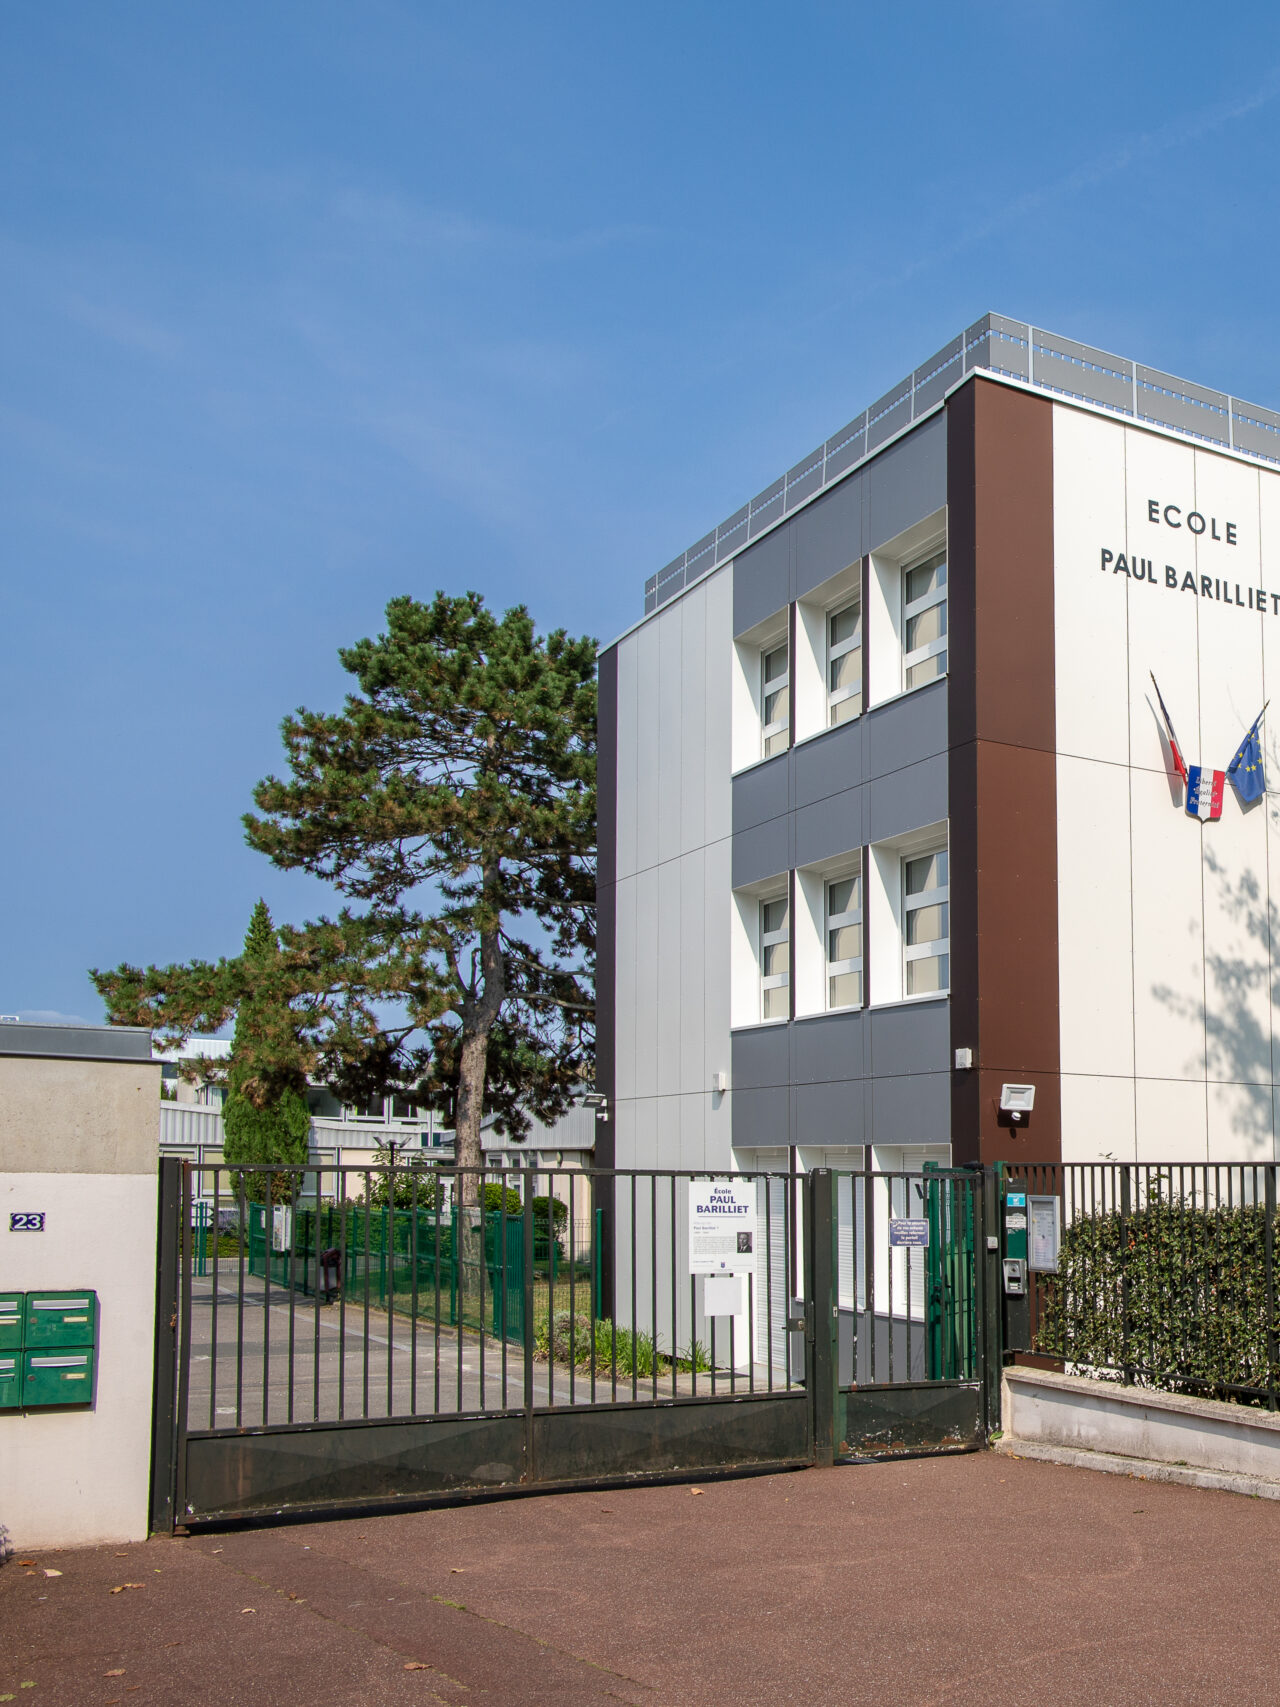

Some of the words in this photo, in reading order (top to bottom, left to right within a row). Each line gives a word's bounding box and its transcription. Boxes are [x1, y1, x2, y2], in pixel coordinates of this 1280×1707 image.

[1148, 499, 1237, 546] ECOLE
[1100, 548, 1158, 584] PAUL
[1165, 565, 1280, 616] BARILLIET
[710, 1196, 736, 1204] PAUL
[696, 1205, 749, 1213] BARILLIET
[14, 1214, 41, 1229] 23
